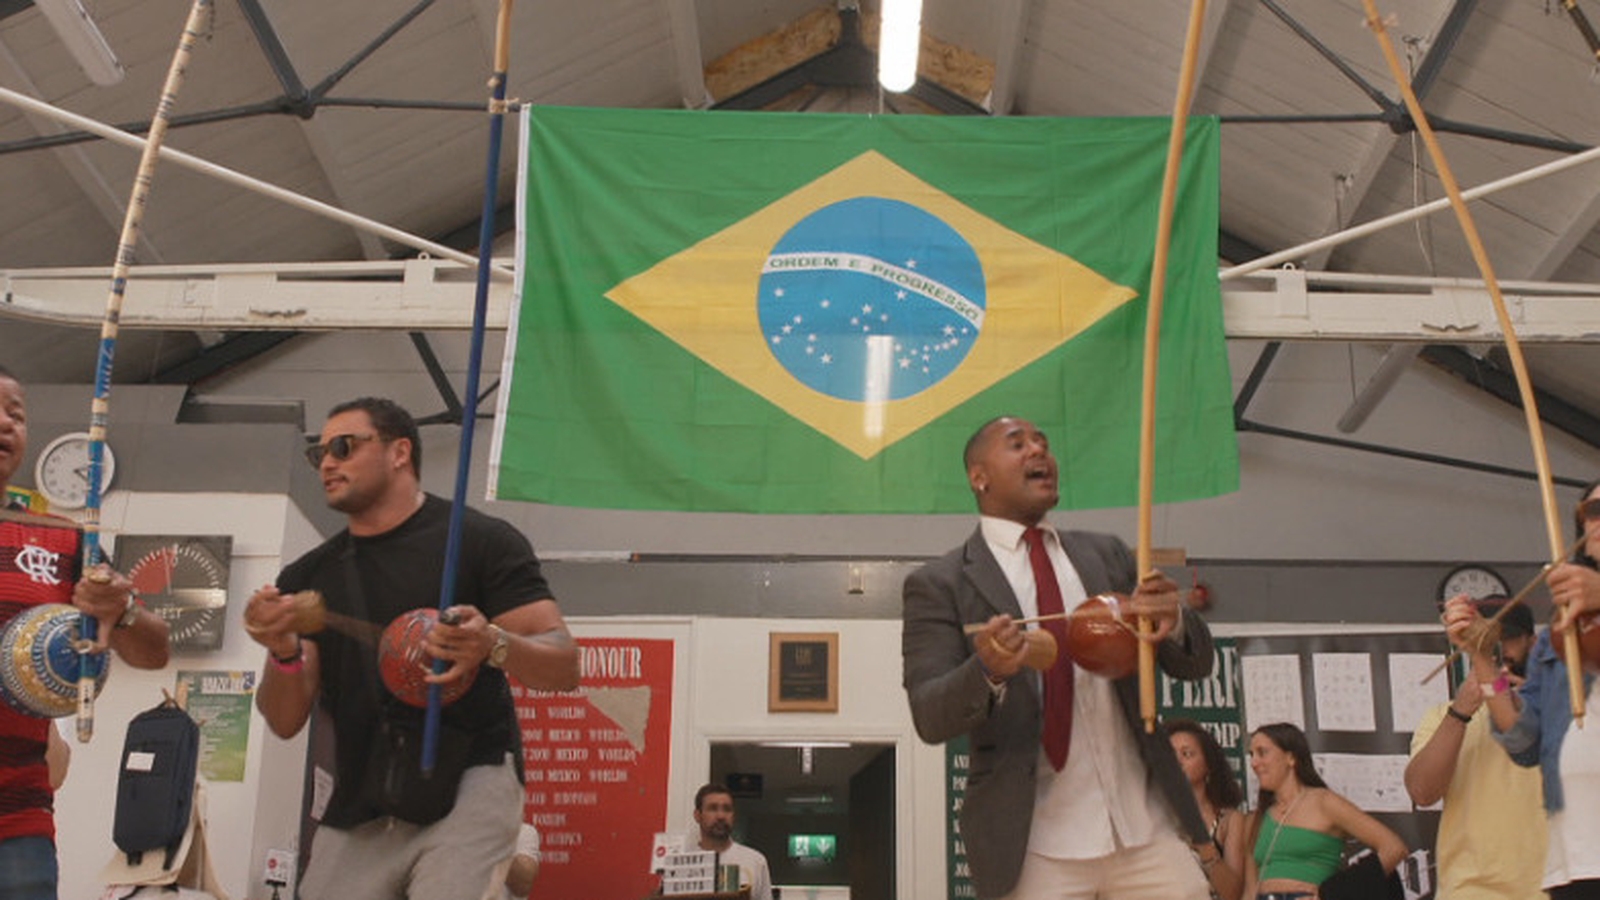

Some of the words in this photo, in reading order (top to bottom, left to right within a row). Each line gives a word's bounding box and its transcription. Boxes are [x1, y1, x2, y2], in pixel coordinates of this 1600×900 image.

[770, 257, 839, 269] ORDEM
[849, 258, 861, 268] E
[871, 264, 979, 321] PROGRESSO
